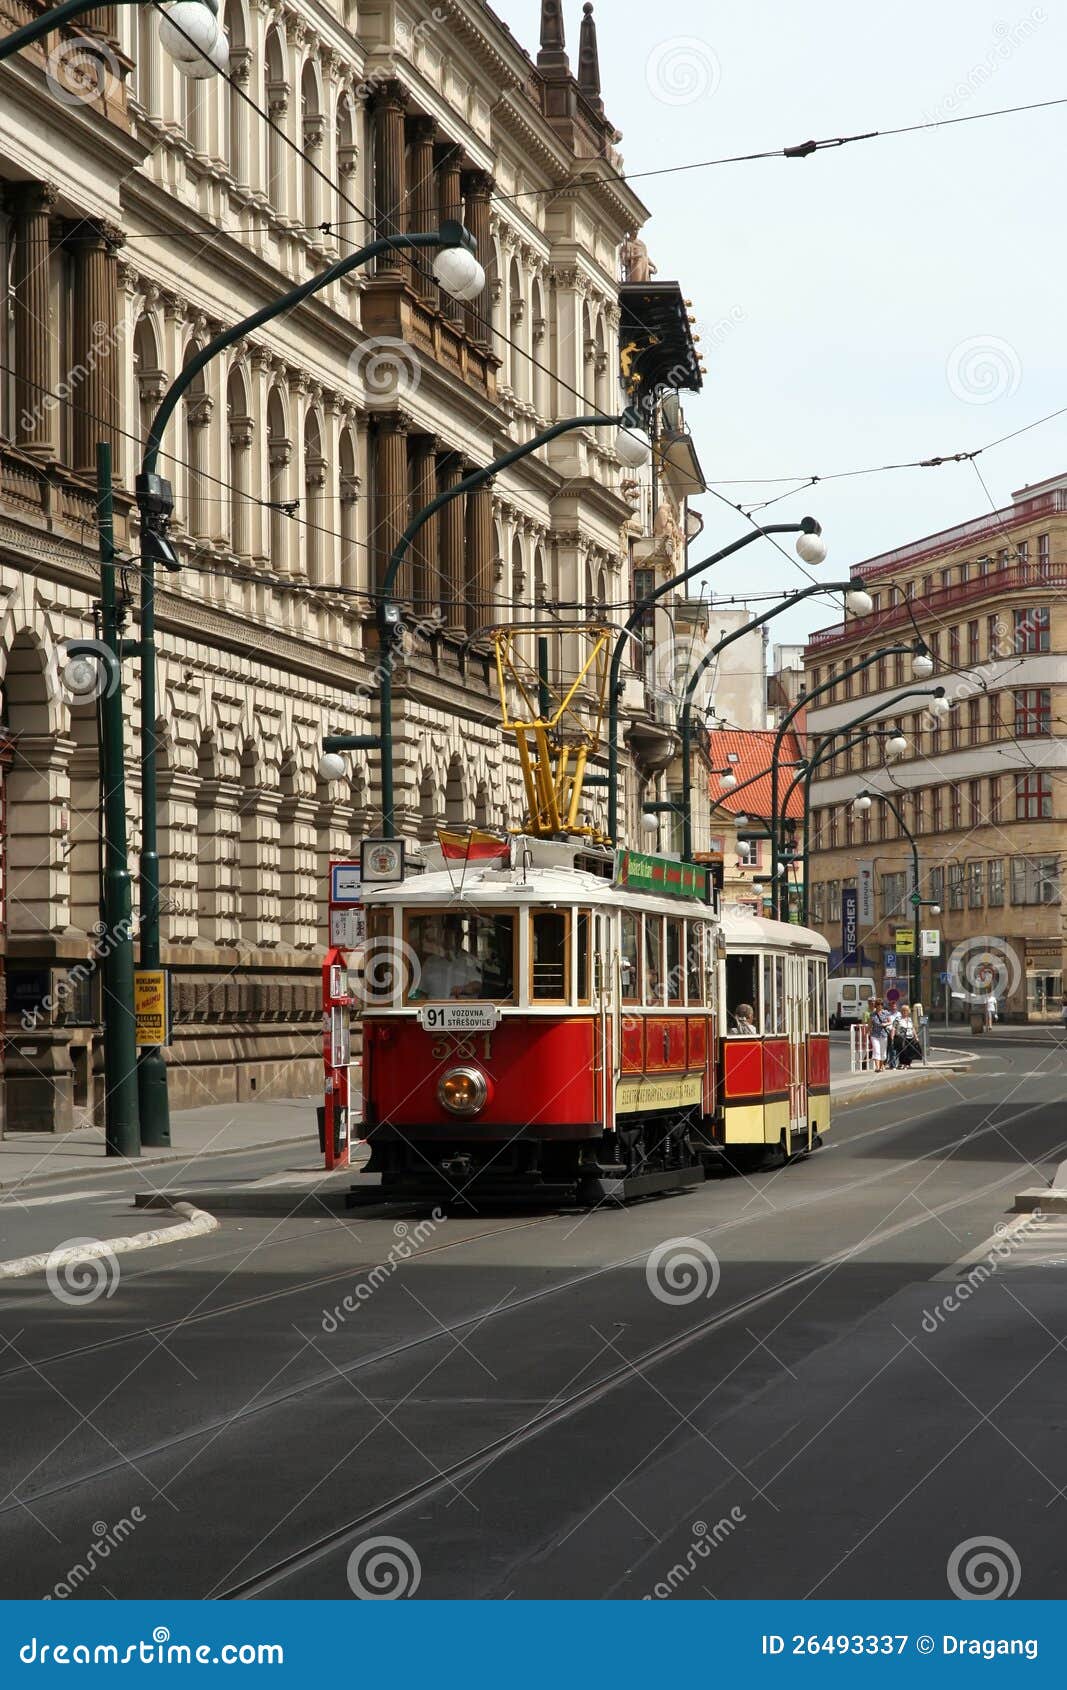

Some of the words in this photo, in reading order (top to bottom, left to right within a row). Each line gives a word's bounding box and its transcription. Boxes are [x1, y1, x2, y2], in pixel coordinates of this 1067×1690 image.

[847, 898, 856, 953] FISCHER
[427, 1009, 446, 1026] 91
[451, 1009, 484, 1017] VOZOVNA
[447, 1018, 492, 1026] STŘEŠOVICE
